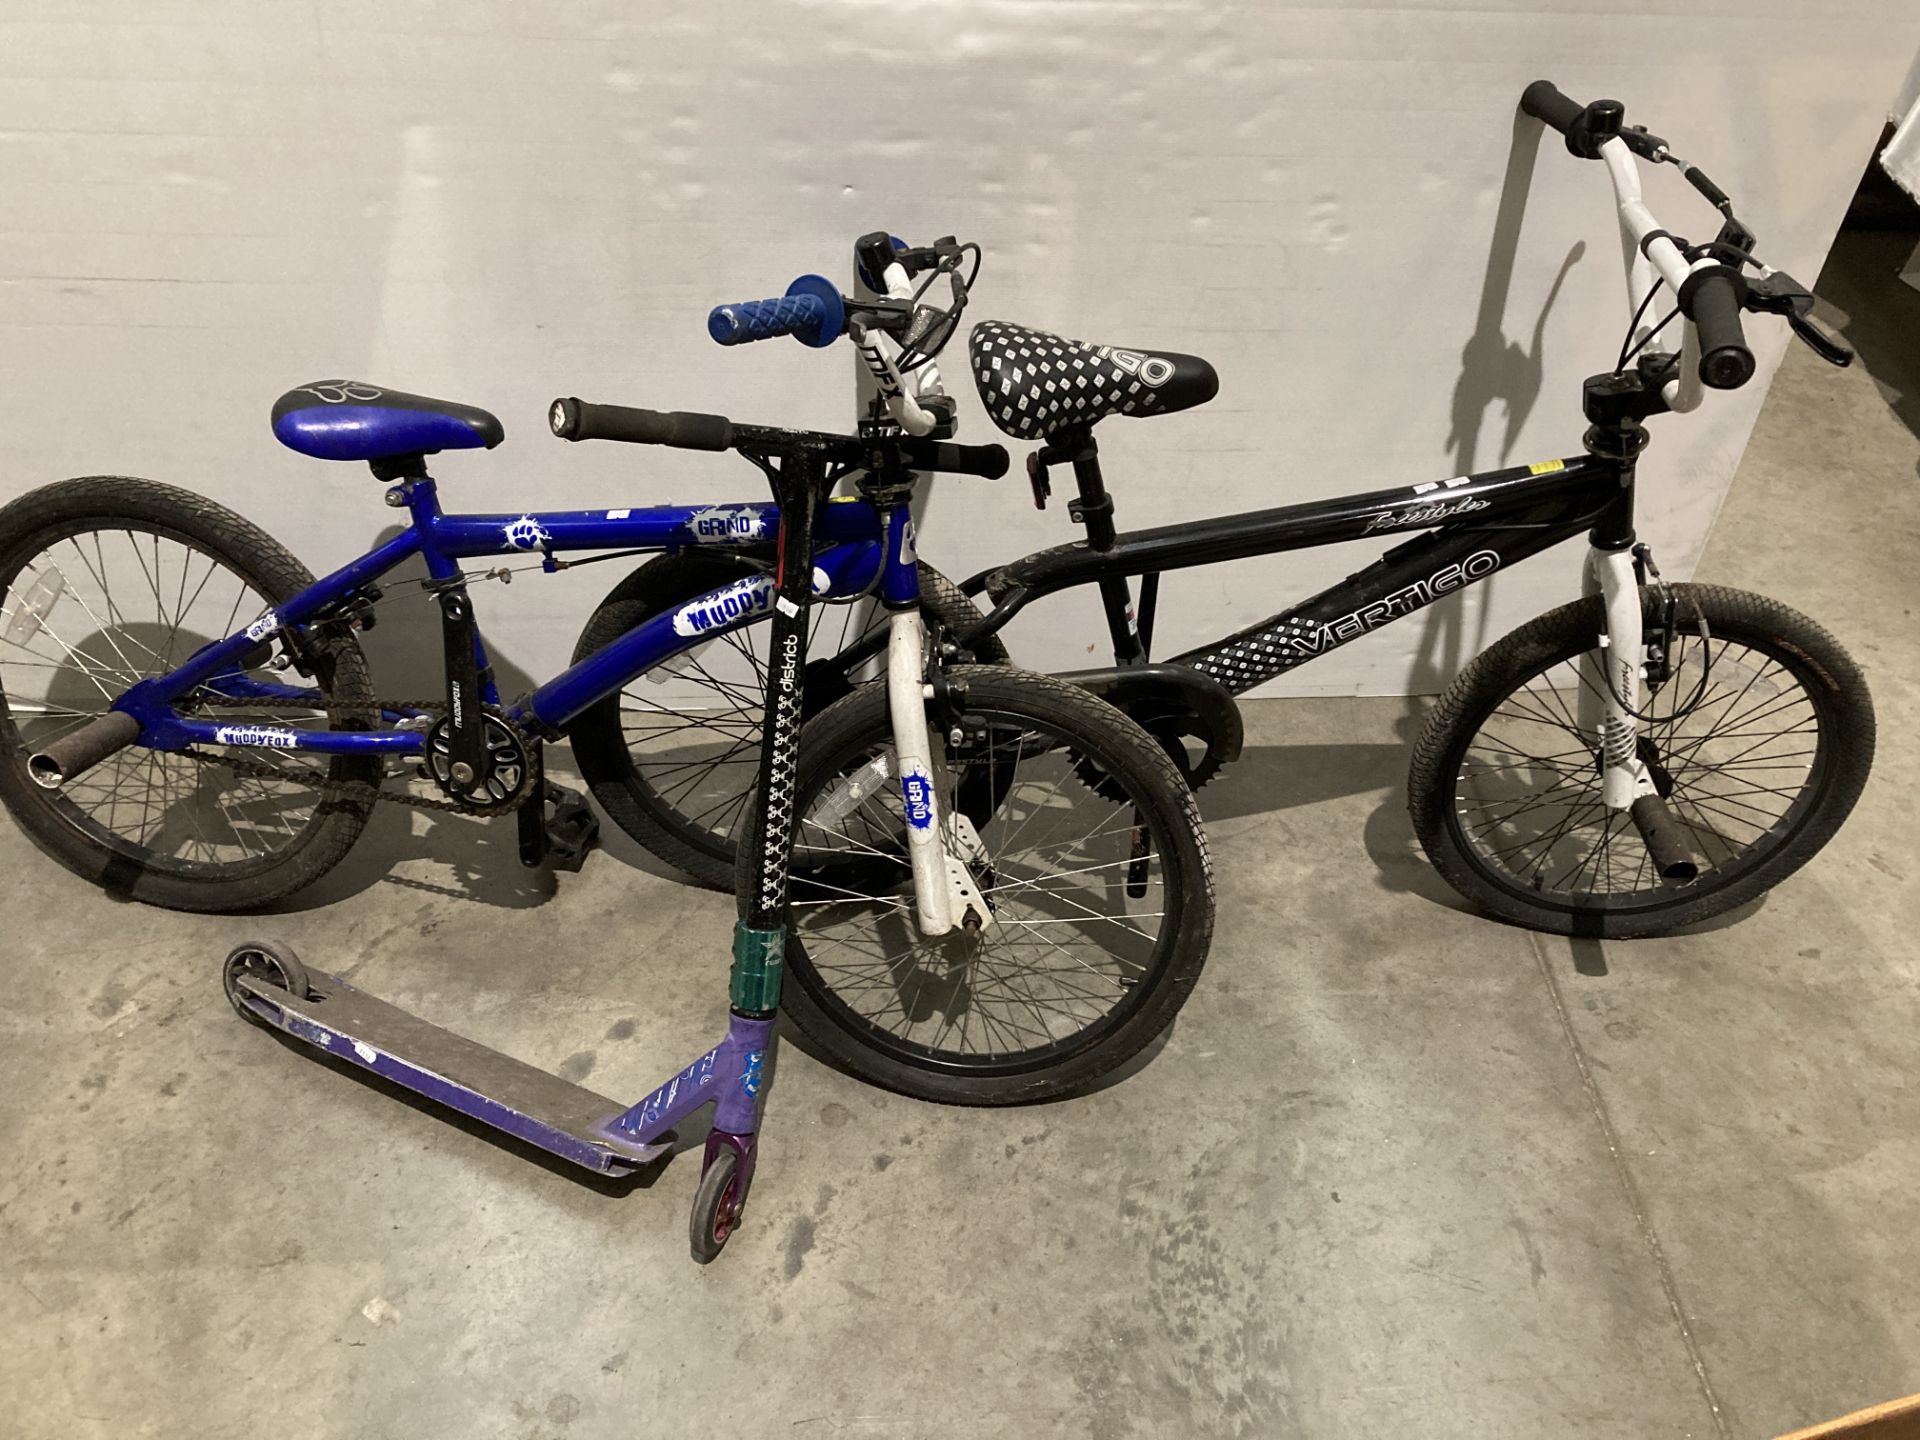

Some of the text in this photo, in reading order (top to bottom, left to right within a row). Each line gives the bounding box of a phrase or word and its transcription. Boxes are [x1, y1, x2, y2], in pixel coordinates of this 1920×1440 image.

[687, 584, 776, 632] MUDDY
[1291, 550, 1500, 653] VERTIGO
[779, 634, 798, 692] district
